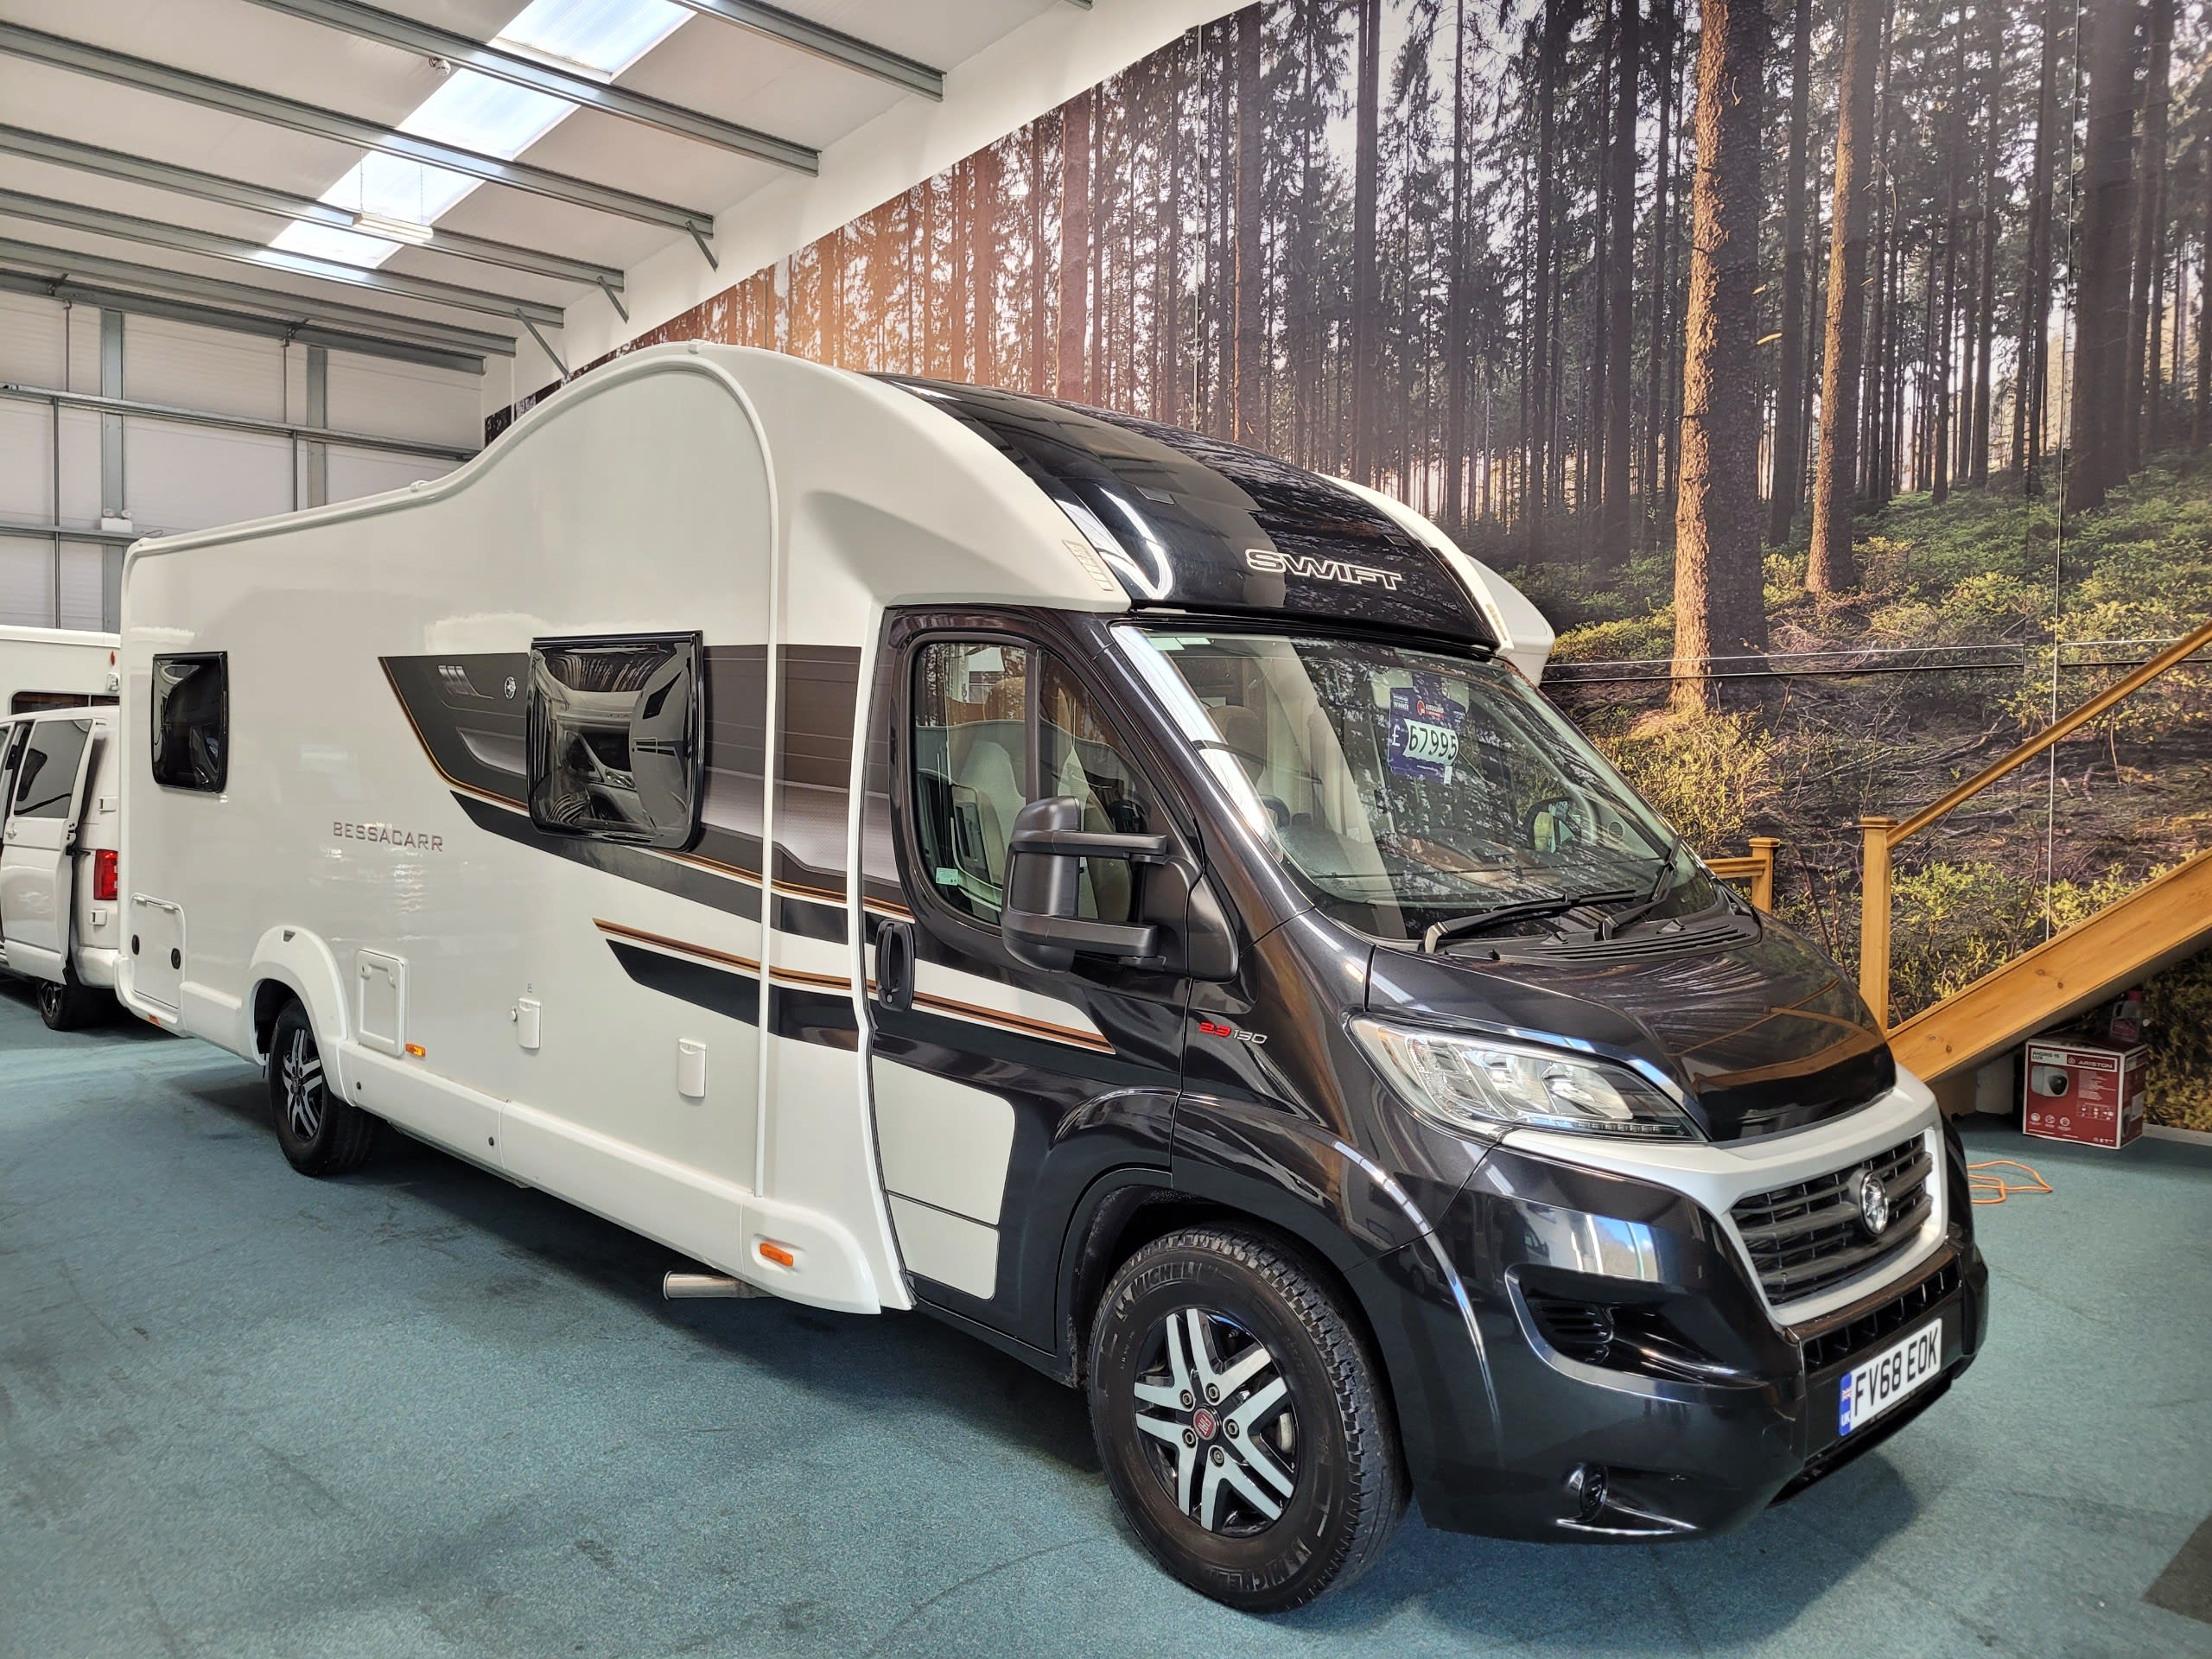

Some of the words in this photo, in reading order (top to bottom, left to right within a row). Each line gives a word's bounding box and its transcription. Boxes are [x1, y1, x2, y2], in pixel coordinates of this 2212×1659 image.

[1244, 548, 1403, 591] SWIFT
[1393, 702, 1409, 711] WINNER
[1392, 724, 1401, 747] £
[1408, 725, 1458, 760] 67995
[334, 822, 443, 852] BESSACARR
[1198, 1021, 1231, 1038] 2.3
[1233, 1028, 1268, 1045] 130
[2078, 1060, 2113, 1069] ARISTON
[1854, 1350, 1902, 1418] FV68
[1907, 1325, 1939, 1383] EOK
[1198, 1414, 1212, 1436] FIAT
[1840, 1412, 1851, 1426] UK
